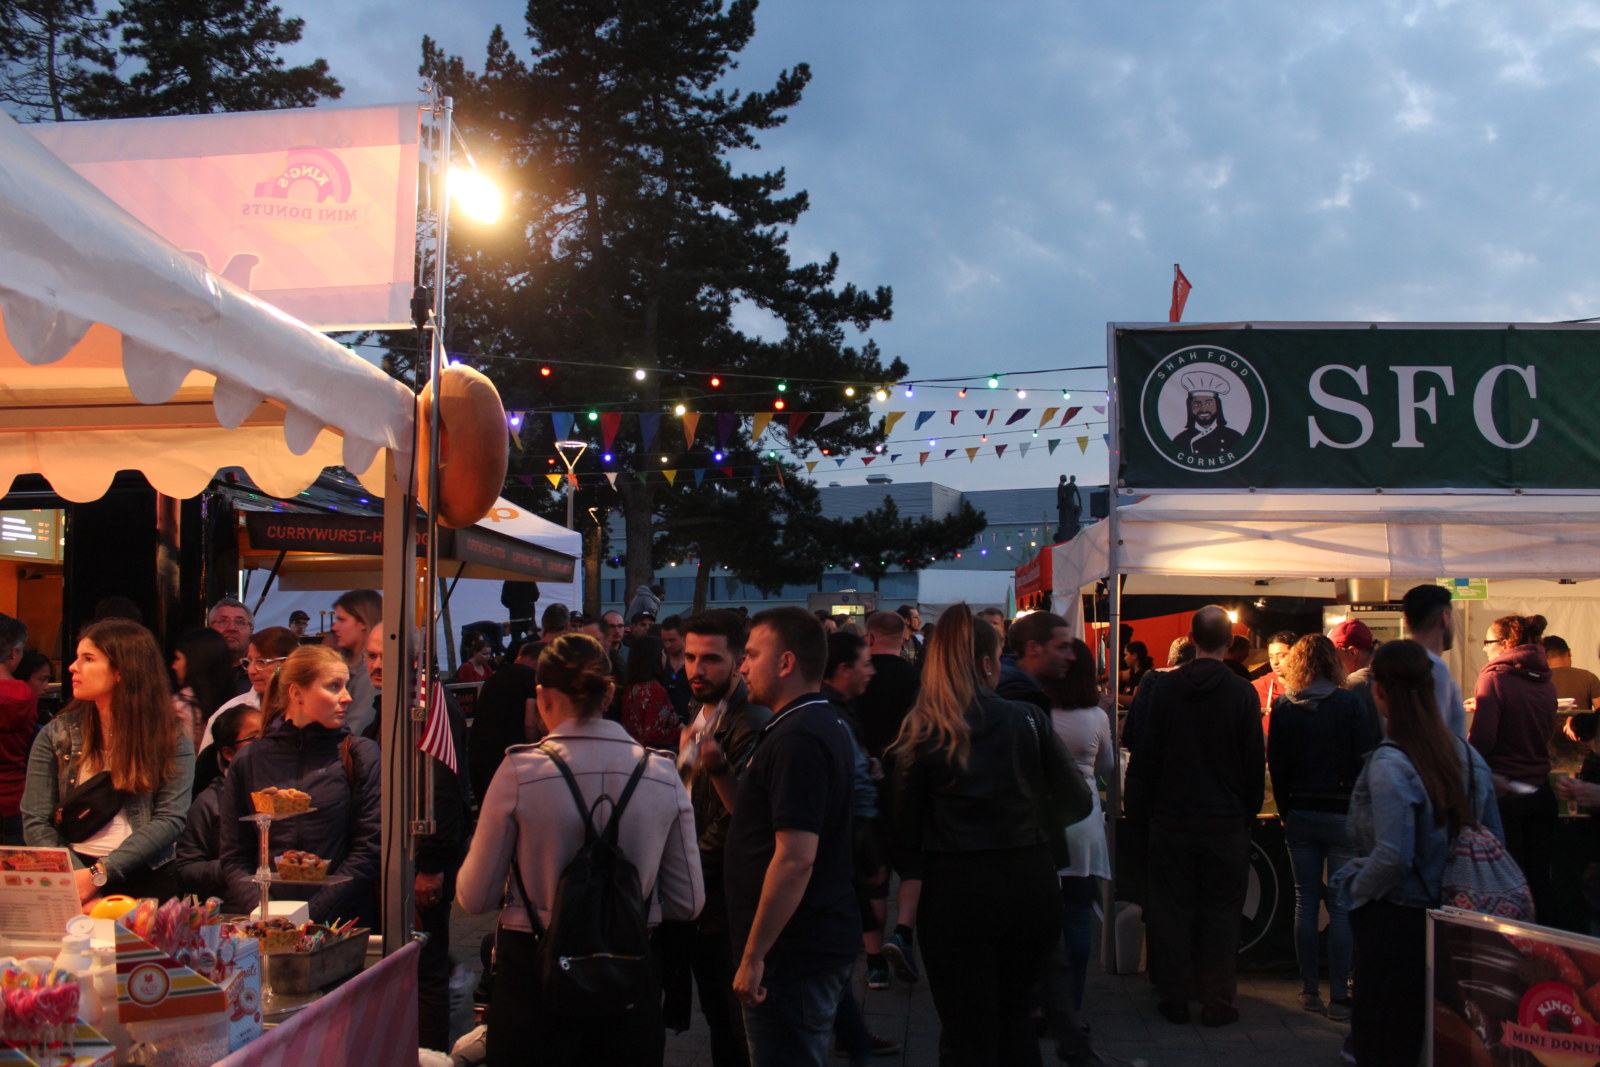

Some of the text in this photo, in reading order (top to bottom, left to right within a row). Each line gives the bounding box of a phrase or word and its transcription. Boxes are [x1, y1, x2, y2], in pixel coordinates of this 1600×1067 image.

[1157, 351, 1248, 379] SHAH FOOD
[1307, 363, 1540, 449] SFC
[1177, 452, 1236, 466] CORNER
[1536, 999, 1583, 1026] KING'S
[1512, 1030, 1545, 1047] MINI
